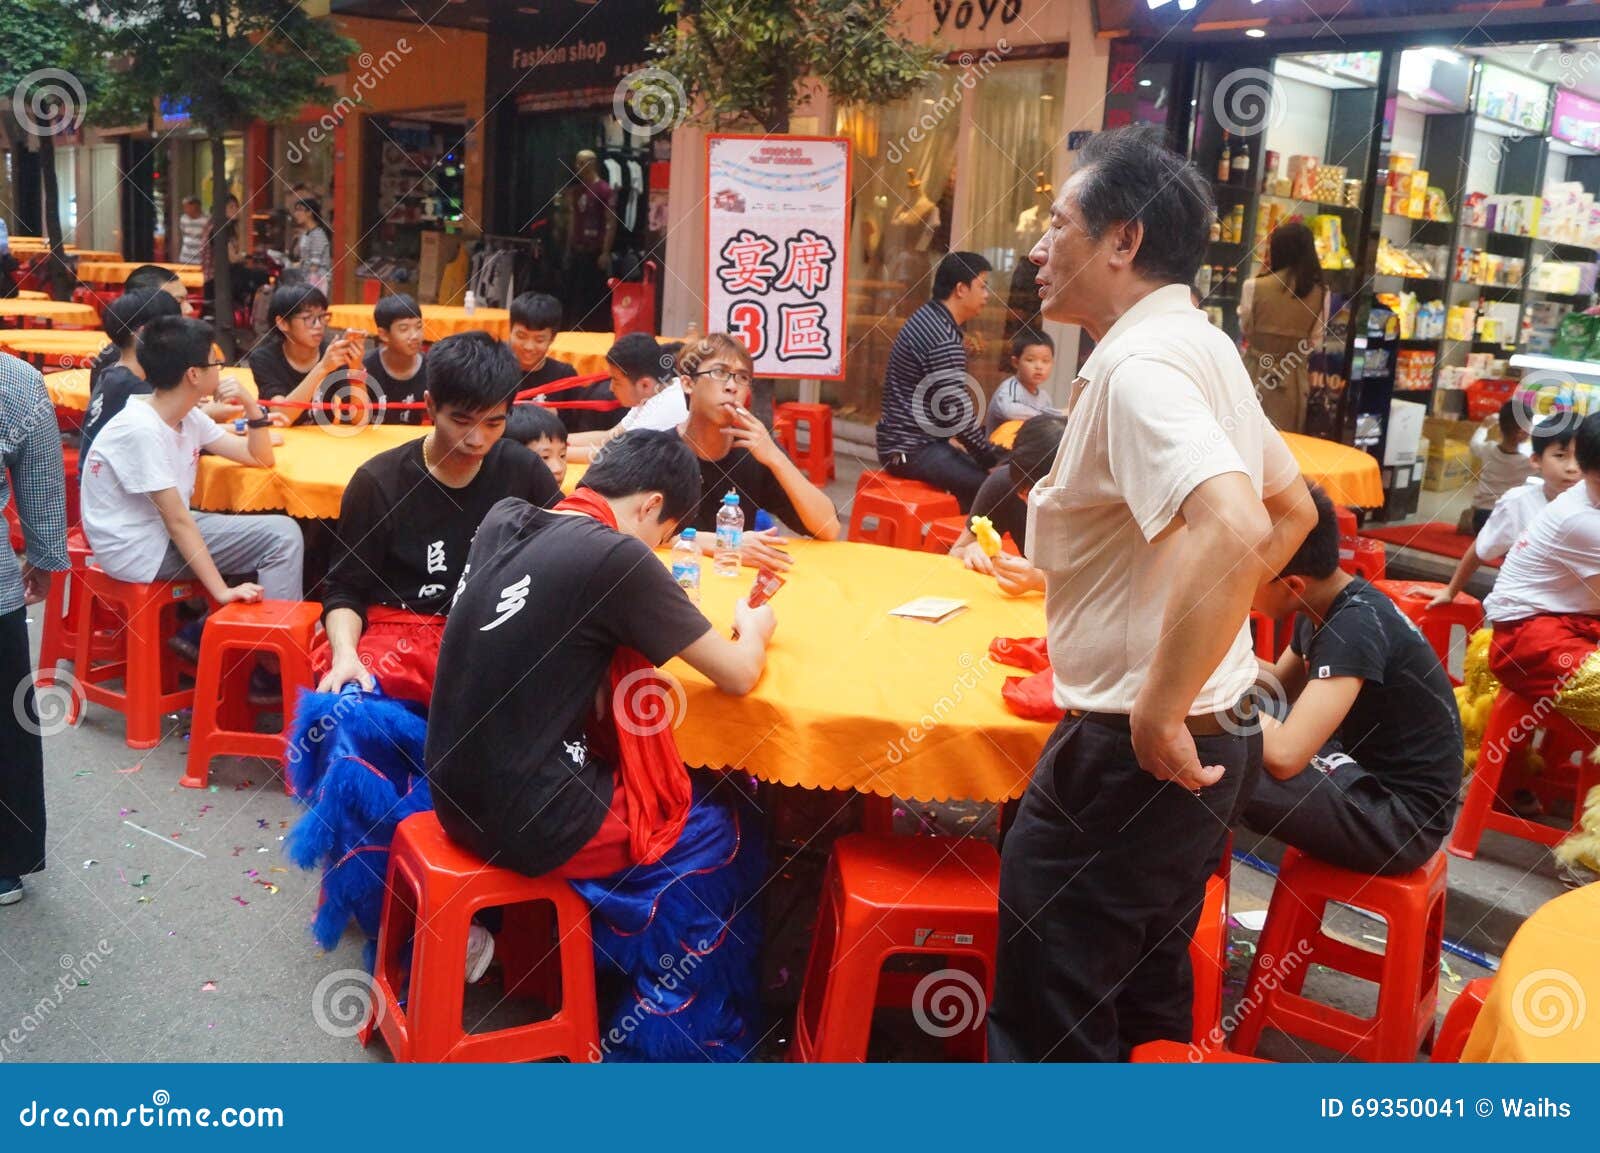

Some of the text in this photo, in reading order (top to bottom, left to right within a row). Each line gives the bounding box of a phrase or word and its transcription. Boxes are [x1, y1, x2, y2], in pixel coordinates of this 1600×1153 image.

[512, 40, 607, 69] Fashion shop
[717, 229, 836, 298] 宴席
